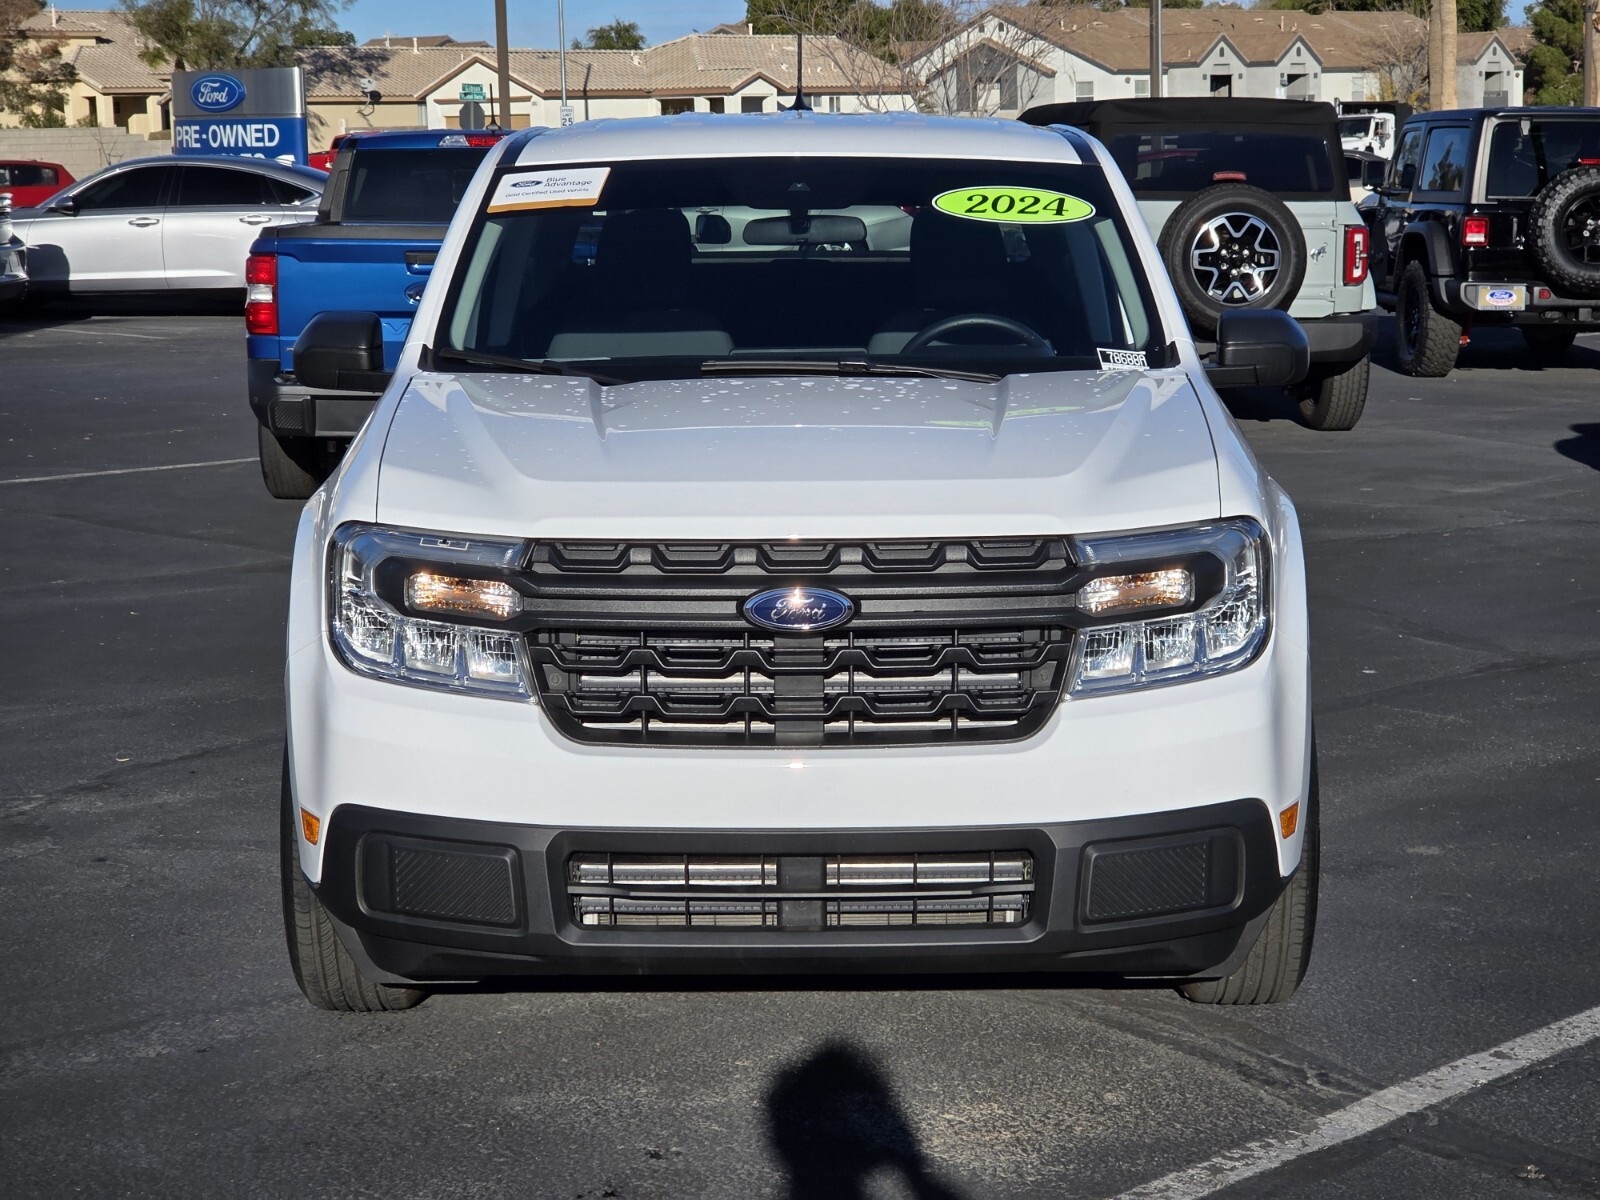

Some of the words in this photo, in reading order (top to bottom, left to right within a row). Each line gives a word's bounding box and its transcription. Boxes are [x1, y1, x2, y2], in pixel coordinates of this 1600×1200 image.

[199, 82, 228, 103] Ford
[562, 118, 573, 126] 25
[176, 124, 280, 148] PRE-OWNED
[544, 180, 592, 188] Advantage
[964, 194, 1069, 217] 2024
[1106, 351, 1148, 367] 78688A
[771, 597, 827, 621] Ford
